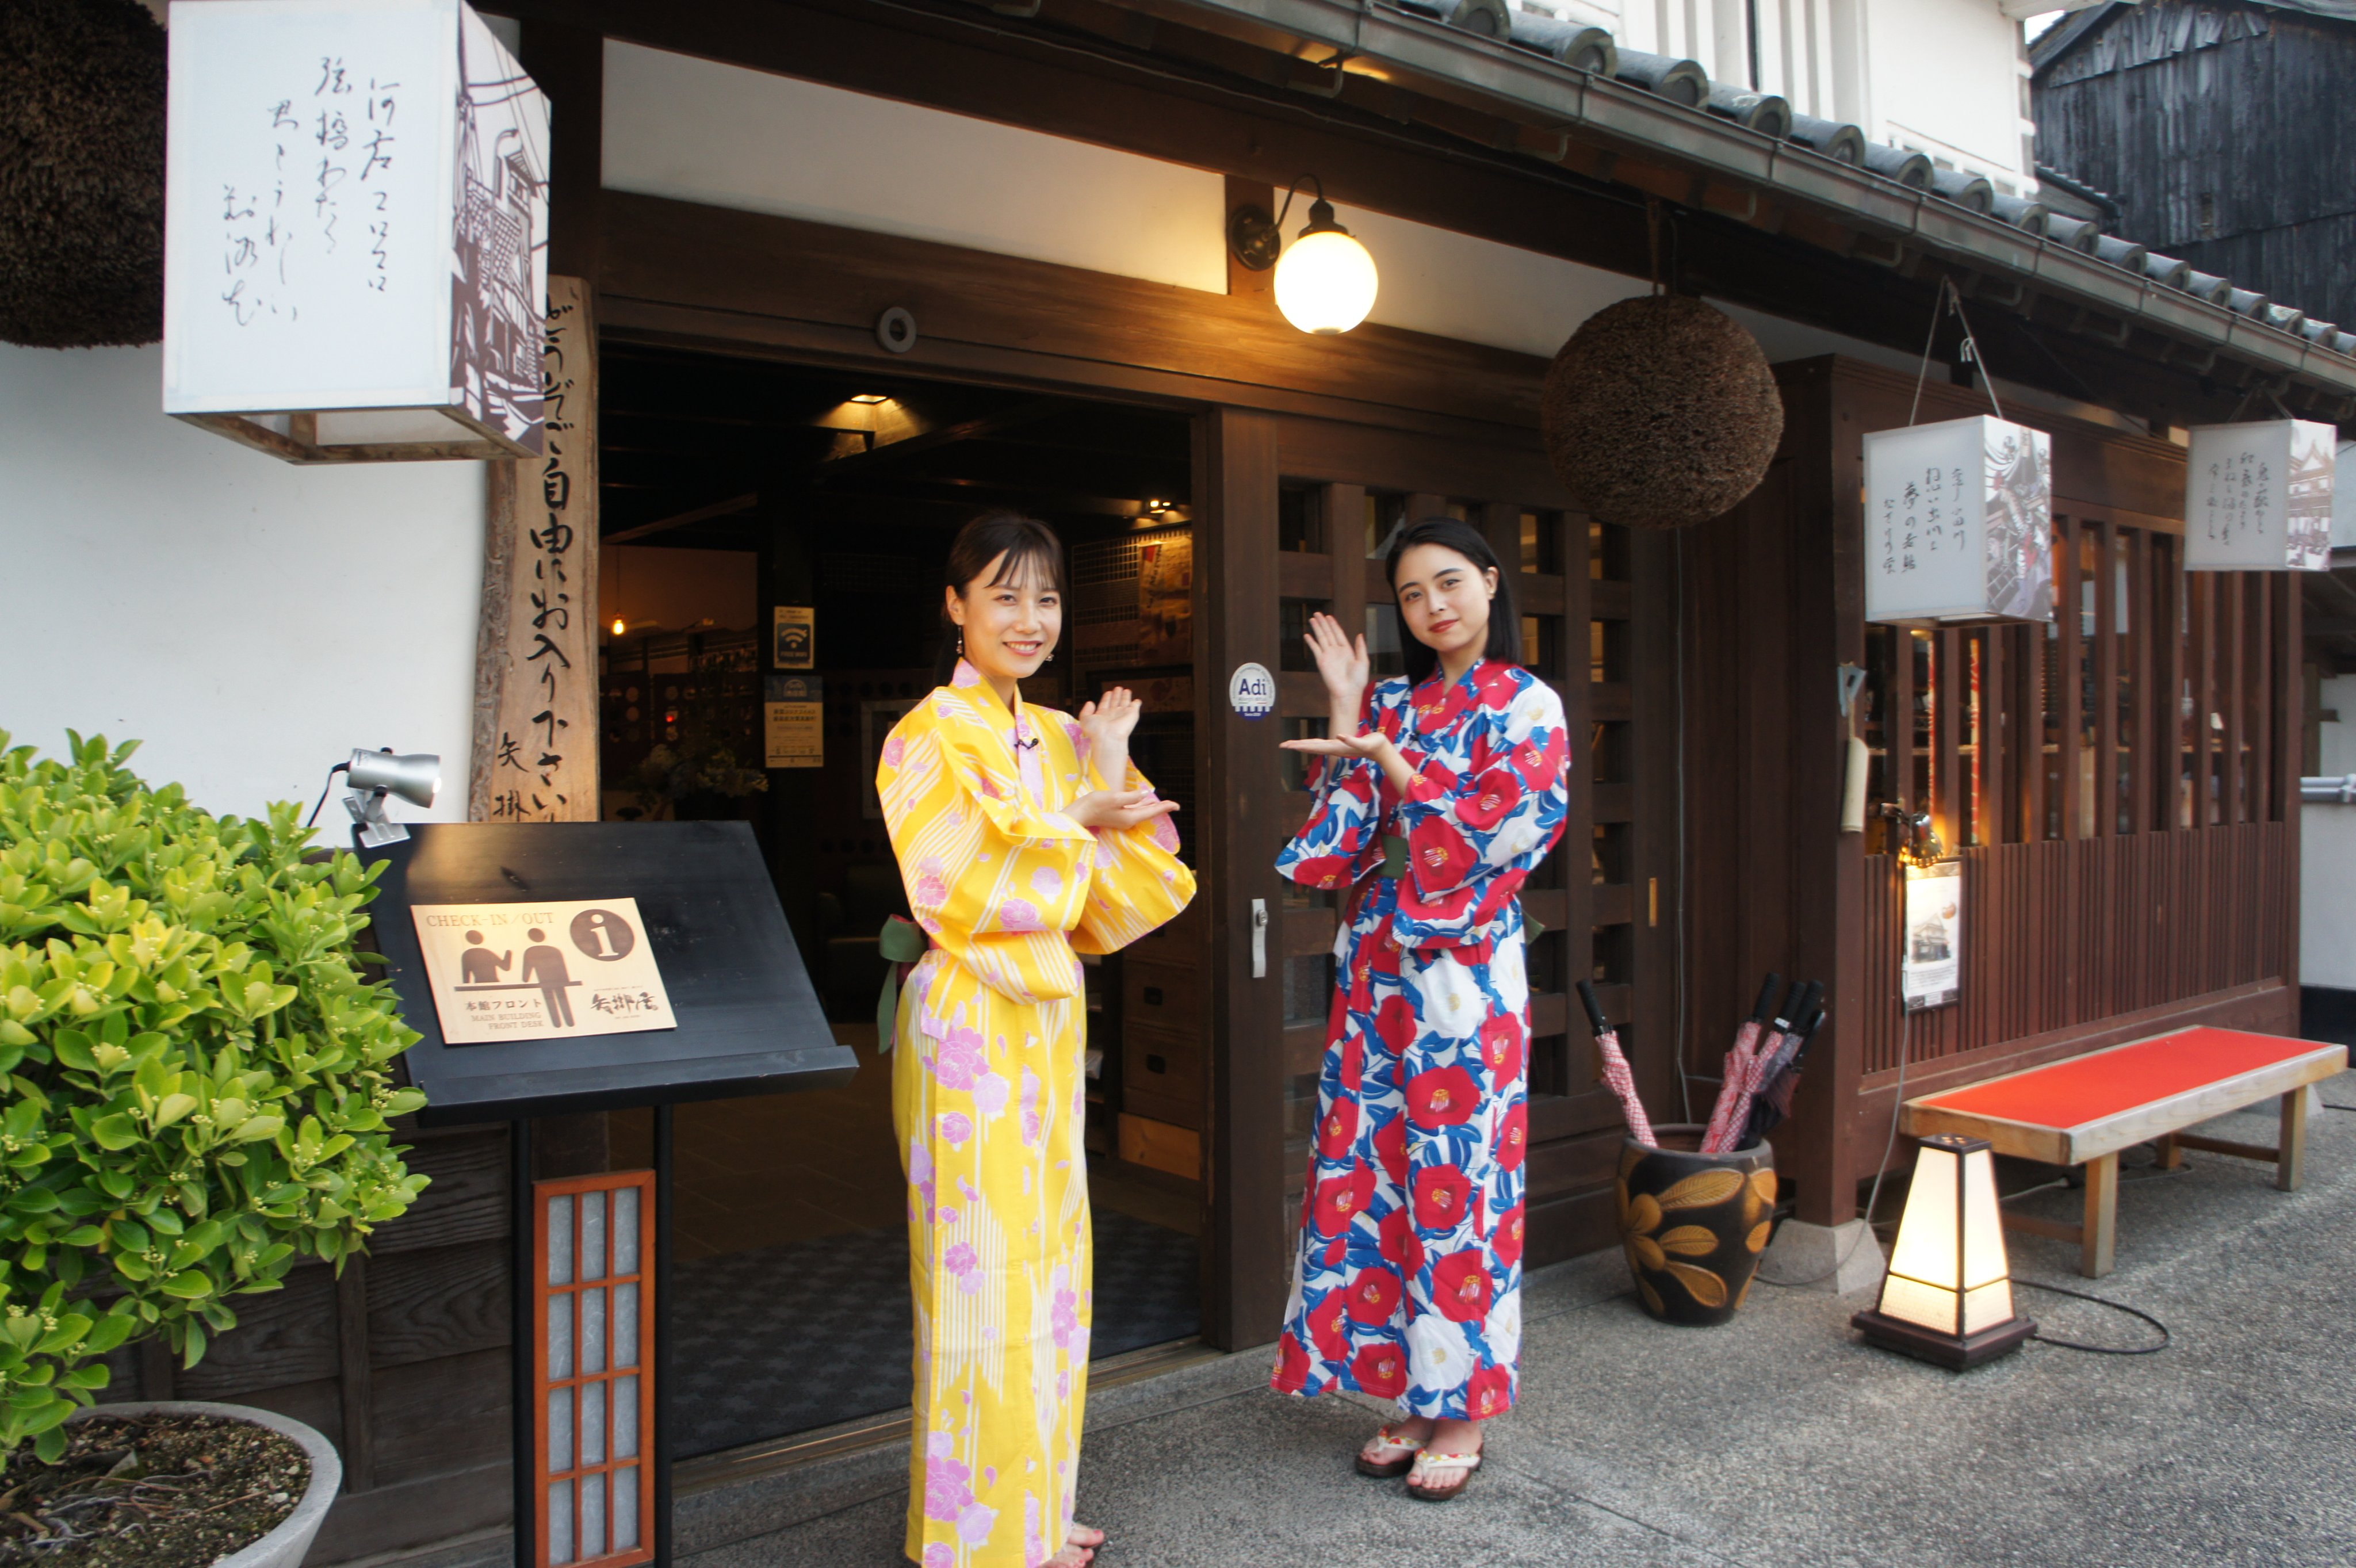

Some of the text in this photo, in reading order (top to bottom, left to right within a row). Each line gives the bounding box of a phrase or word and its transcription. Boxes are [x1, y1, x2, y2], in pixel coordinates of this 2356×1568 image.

[1238, 678, 1267, 695] Adi
[465, 998, 541, 1011] 本館フロント
[498, 1012, 542, 1020] BUILDING
[488, 1020, 544, 1030] FRONT DESK
